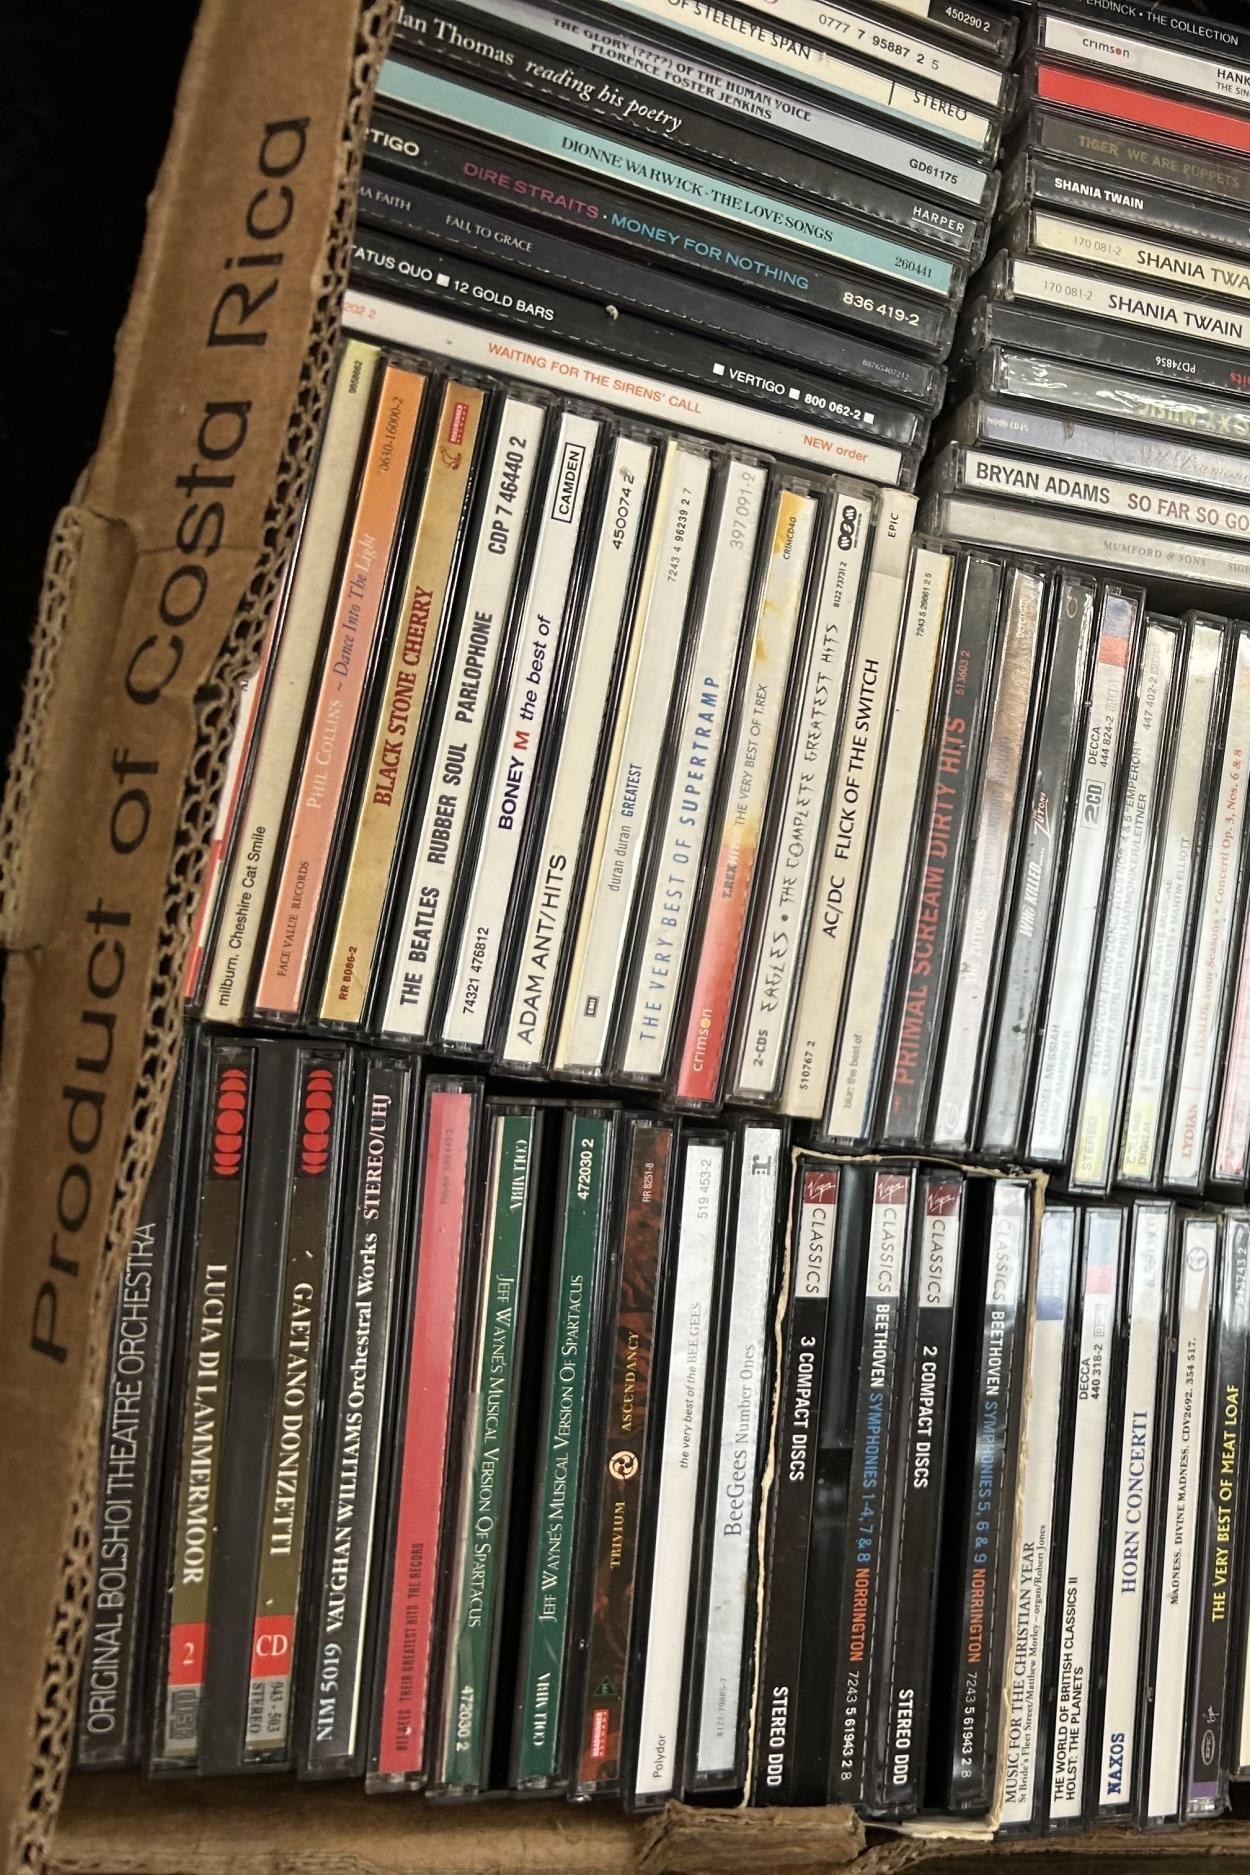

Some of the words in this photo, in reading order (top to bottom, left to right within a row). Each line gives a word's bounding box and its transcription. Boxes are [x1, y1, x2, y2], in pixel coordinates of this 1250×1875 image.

[1170, 18, 1239, 47] COLLECTION
[433, 18, 514, 67] Thomas
[524, 57, 596, 104] reading
[598, 82, 624, 114] his
[625, 93, 683, 134] poetry
[911, 89, 969, 122] STEREO
[562, 136, 621, 171] DIONNE
[624, 155, 704, 198] WARWICK
[711, 188, 744, 212] THE
[744, 198, 784, 225] LOVE
[784, 212, 833, 243] SONGS
[908, 156, 959, 187] GD61175
[205, 115, 311, 349] Rica
[463, 162, 509, 192] DIRE
[509, 175, 600, 220] STRAITS
[610, 212, 680, 246] MONEY
[683, 237, 723, 260] FOR
[725, 249, 809, 291] NOTHING
[912, 205, 965, 234] HARPER
[472, 284, 514, 308] GOLD
[516, 300, 555, 321] BARS
[1108, 294, 1178, 326] SHANIA
[1183, 312, 1243, 340] TWAIN
[487, 342, 547, 372] WAITING
[550, 359, 580, 380] FOR
[584, 368, 609, 387] THE
[613, 377, 666, 407] SIRENS'
[669, 395, 702, 414] CALL
[558, 450, 579, 515] CAMDEN
[976, 461, 1040, 491] BRYAN
[1044, 474, 1110, 505] ADAMS
[1128, 492, 1152, 514] SO
[1157, 498, 1190, 521] FAR
[1196, 504, 1220, 526] SO
[123, 398, 252, 706] Costa
[887, 512, 899, 538] EPIC
[402, 586, 434, 665] CHERRY
[455, 611, 493, 724] PARLOPHONE
[853, 658, 880, 730] SWITCH
[388, 671, 417, 735] STONE
[372, 736, 403, 806] BLACK
[443, 742, 468, 786] SOUL
[497, 756, 526, 830] BONEY
[513, 730, 530, 750] M
[678, 676, 720, 828] SUPERTRAMP
[848, 734, 867, 773] THE
[110, 746, 160, 855] of
[427, 794, 457, 865] RUBBER
[835, 801, 857, 860] FLICK
[229, 891, 252, 950] Cheshire
[250, 825, 266, 863] Smile
[822, 876, 845, 938] AC/DC
[408, 887, 440, 963] BEATLES
[471, 926, 489, 974] 476812
[896, 985, 927, 1087] PRIMAL
[913, 869, 946, 976] SCREAM
[930, 783, 958, 859] DIRTY
[400, 973, 424, 1007] THE
[515, 976, 545, 1045] ADAM
[31, 897, 133, 1365] Product
[357, 1232, 377, 1295] Works
[804, 1208, 827, 1294] CLASSICS
[118, 1222, 156, 1377] ORCHESTRA
[200, 1263, 228, 1344] LUCIA
[567, 1275, 584, 1359] SPARTACUS
[284, 1281, 314, 1408] GAETANO
[348, 1300, 374, 1407] Orchestral
[741, 1344, 756, 1384] Ones
[870, 1304, 889, 1389] BEETHOVEN
[620, 1331, 640, 1432] ASCENDANCY
[792, 1353, 813, 1429] COMPACT
[1225, 1383, 1240, 1427] LOAF
[108, 1380, 143, 1492] THEATRE
[736, 1386, 753, 1455] Number
[1221, 1430, 1238, 1474] MEAT
[182, 1383, 218, 1586] LAMMERMOOR
[270, 1416, 304, 1556] DONIZETTI
[336, 1412, 362, 1526] WILLIAMS
[788, 1435, 806, 1482] DISCS
[1124, 1410, 1149, 1525] CONCERTI
[1216, 1508, 1231, 1543] BEST
[1219, 1481, 1234, 1508] OF
[97, 1505, 133, 1612] BOLSHOI
[609, 1501, 626, 1570] TRIVIUM
[1121, 1530, 1140, 1595] HORN
[1212, 1547, 1230, 1584] VERY
[326, 1526, 353, 1633] VAUGHAN
[467, 1542, 492, 1629] SPARTACUS
[1211, 1586, 1227, 1623] THE
[256, 1634, 288, 1657] CD
[848, 1568, 871, 1662] NORRINGTON
[87, 1615, 123, 1736] ORIGINAL
[320, 1642, 341, 1696] 5019
[1055, 1725, 1070, 1774] WORLD
[1065, 1590, 1077, 1653] CLASSICS
[315, 1698, 336, 1743] NIM
[770, 1686, 789, 1749] STEREO
[652, 1734, 667, 1779] Polydor
[1004, 1749, 1022, 1804] MUSIC
[1107, 1732, 1125, 1795] NAXOS
